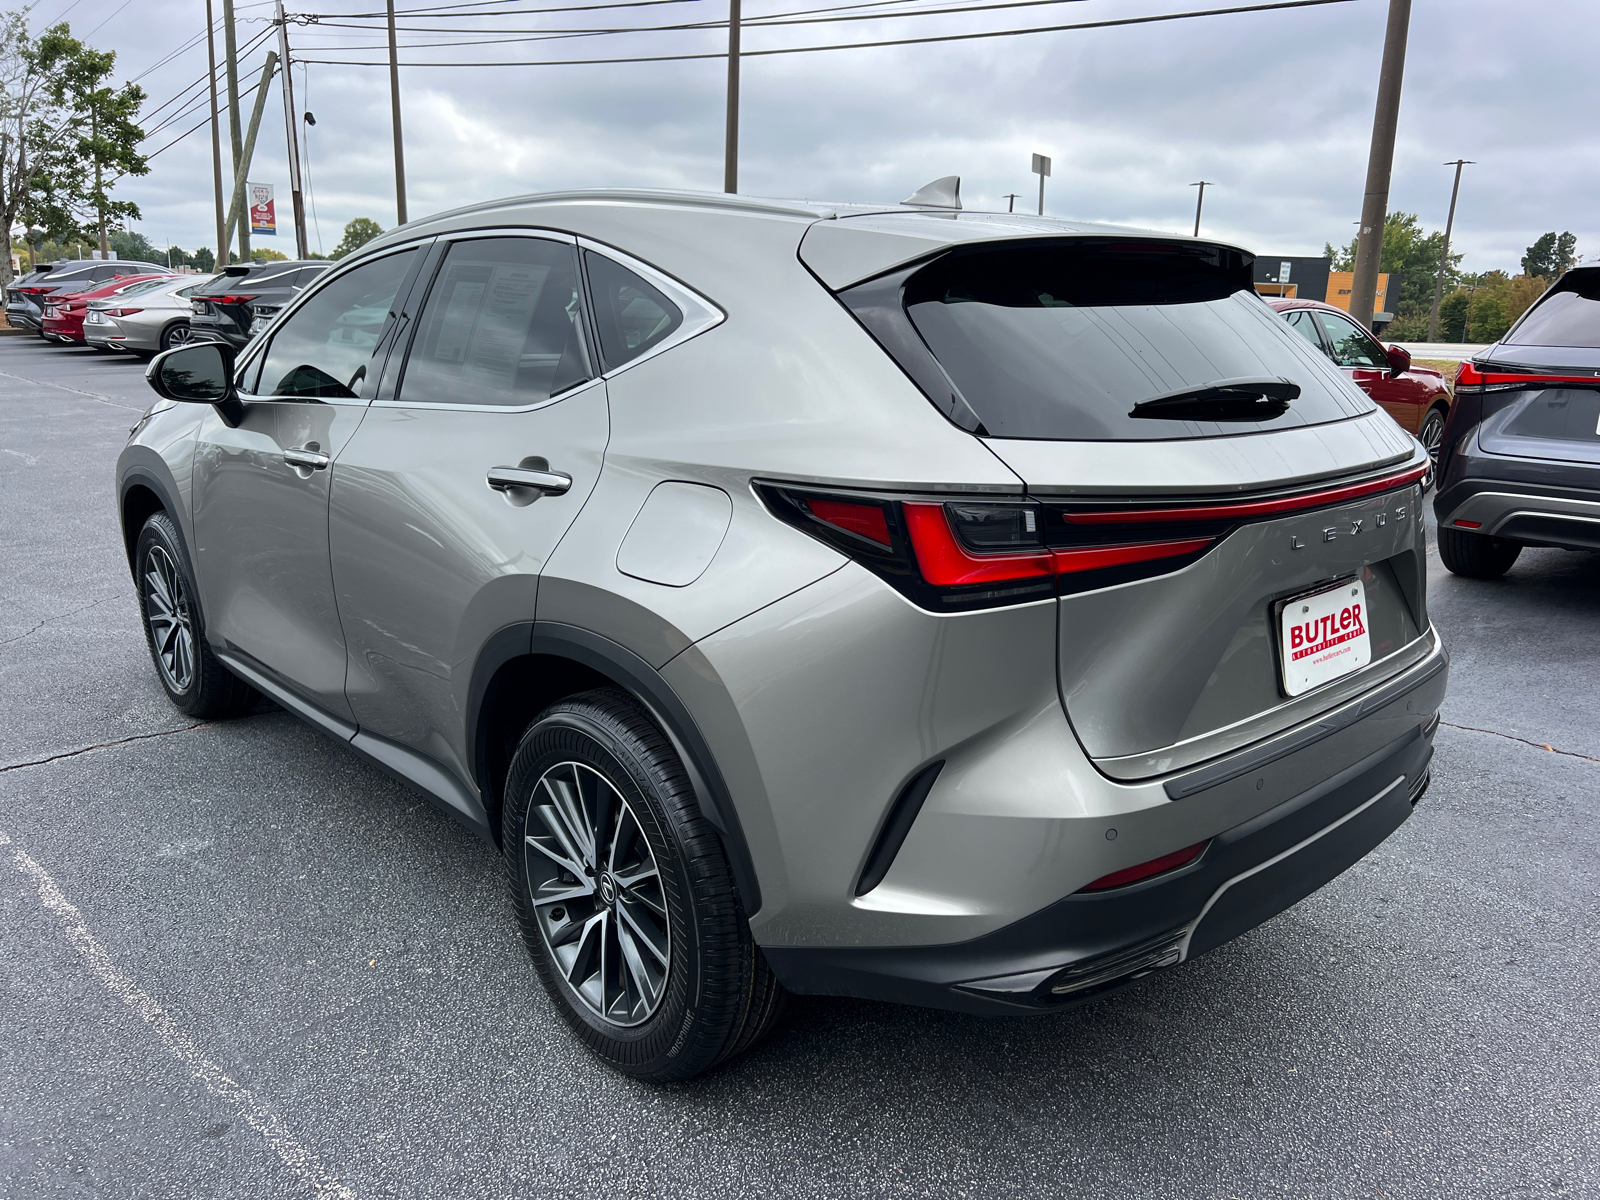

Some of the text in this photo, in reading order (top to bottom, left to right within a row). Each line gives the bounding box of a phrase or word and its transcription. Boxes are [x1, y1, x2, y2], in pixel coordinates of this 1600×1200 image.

[1291, 506, 1406, 550] LEXUS
[1292, 627, 1364, 660] AUTOMOTIVE GROUP
[1313, 646, 1351, 665] www.butlercars.com
[619, 751, 651, 794] ALENZA
